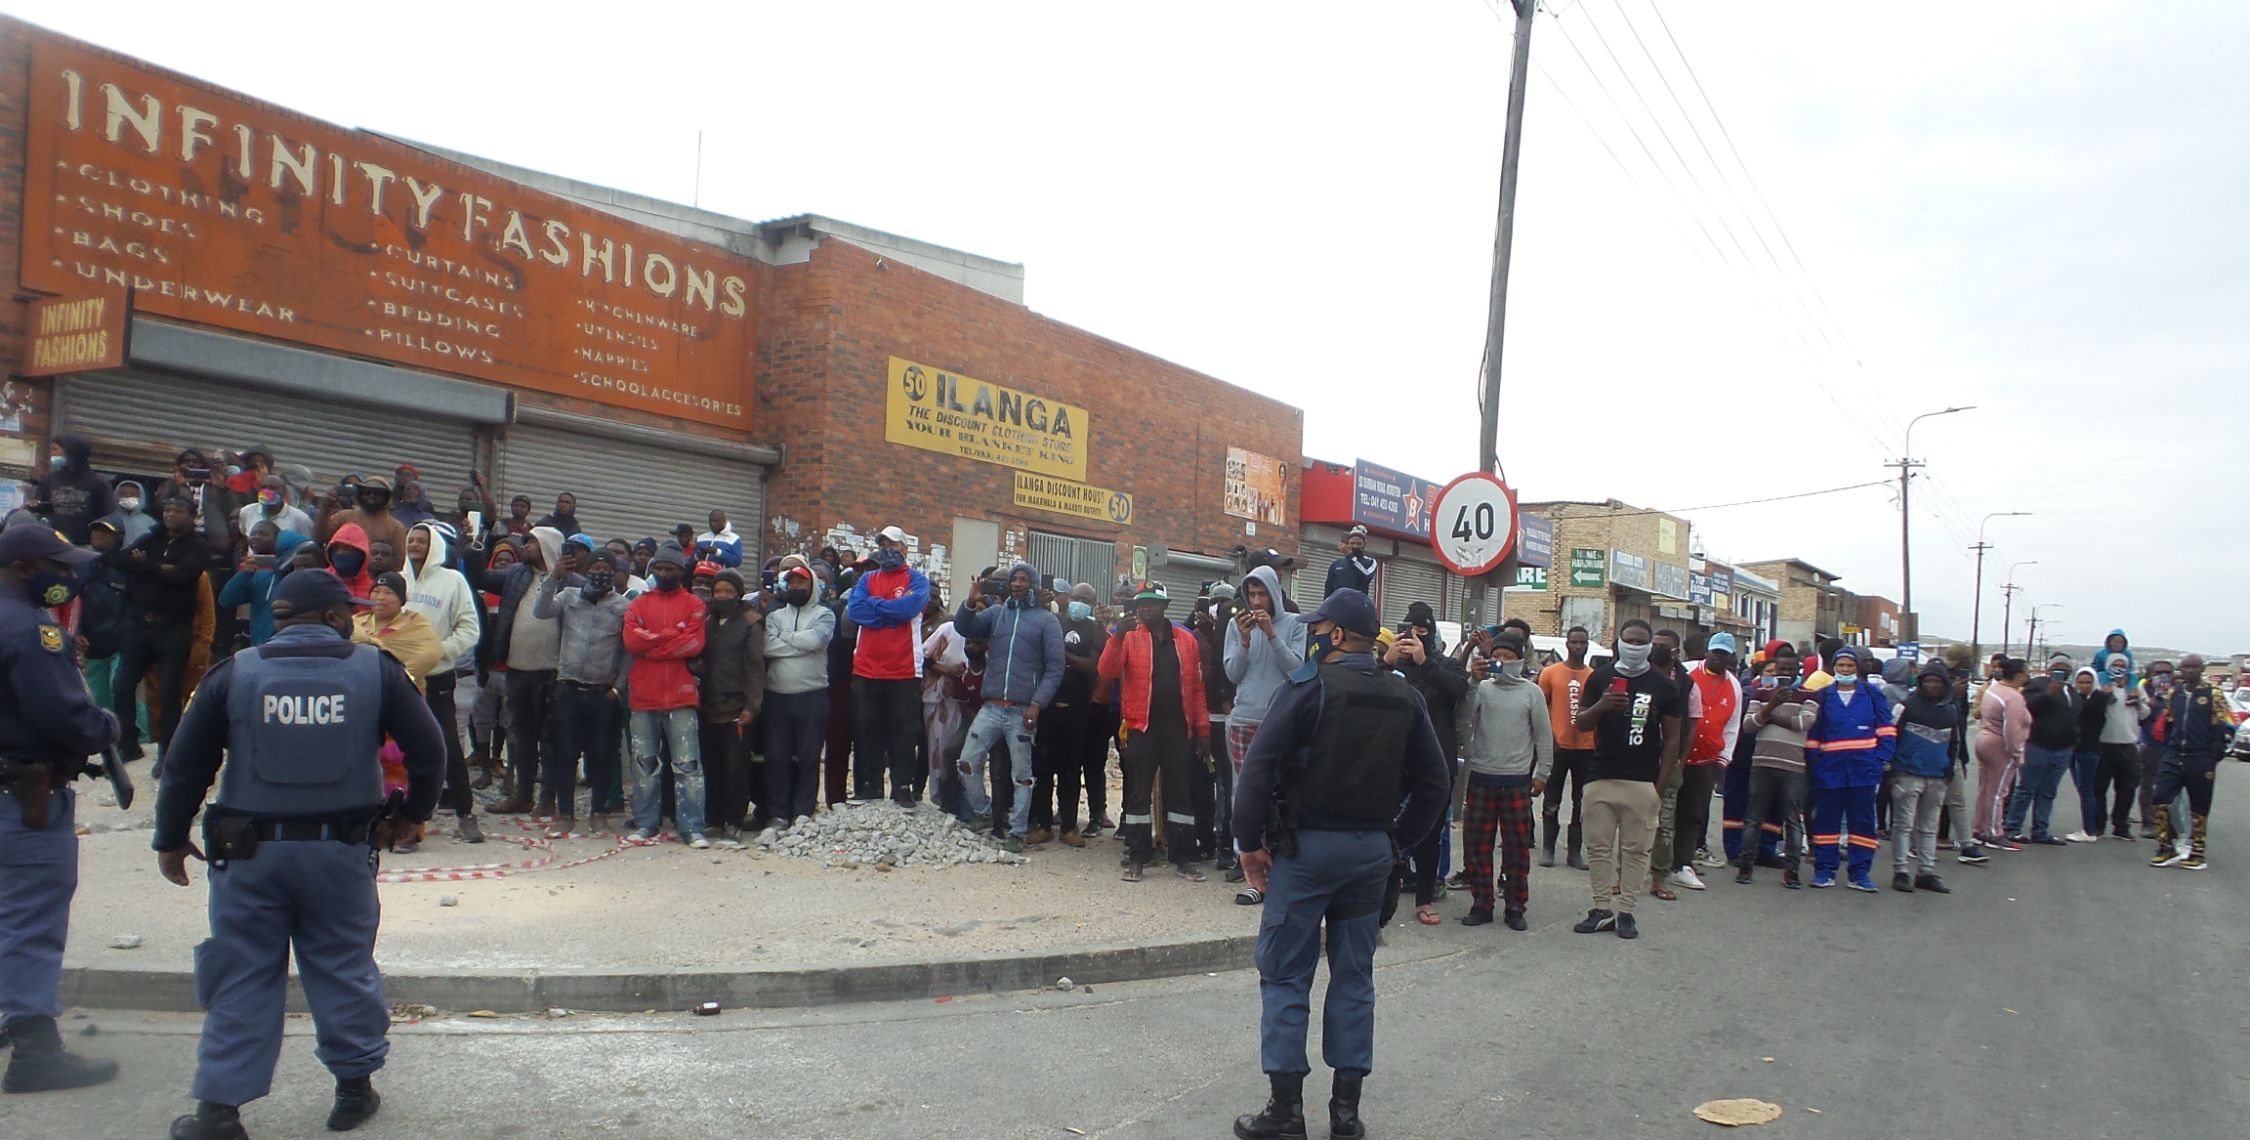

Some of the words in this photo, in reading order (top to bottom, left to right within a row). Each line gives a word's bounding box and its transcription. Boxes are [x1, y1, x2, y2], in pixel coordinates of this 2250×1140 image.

[60, 68, 442, 230] INFINITY
[459, 192, 747, 320] FASHIONS
[79, 163, 265, 225] CLOTHING
[77, 196, 196, 239] SHOES
[73, 230, 169, 264] BAGS
[386, 243, 515, 291] CURTAINS
[75, 261, 295, 323] UNDERWEAR
[385, 271, 524, 319] SUITCASES
[40, 297, 105, 335] INFINITY
[383, 301, 500, 339] BEDDING
[585, 299, 699, 338] KTCHENWARE
[33, 329, 108, 368] FASHIONS
[379, 328, 493, 364] PILLOWS
[935, 372, 1073, 440] ILANGA
[905, 419, 950, 439] YOUR
[908, 405, 932, 421] THE
[936, 411, 988, 434] DISCOUNT
[1042, 436, 1073, 453] STORE
[1016, 474, 1045, 494] ILANGA
[1046, 480, 1082, 500] DISCOUNT
[1016, 493, 1027, 503] FOR
[1408, 498, 1418, 518] B
[1451, 501, 1494, 543] 40
[1576, 548, 1598, 560] HOME
[263, 694, 345, 725] POLICE
[1629, 692, 1652, 746] RETRO
